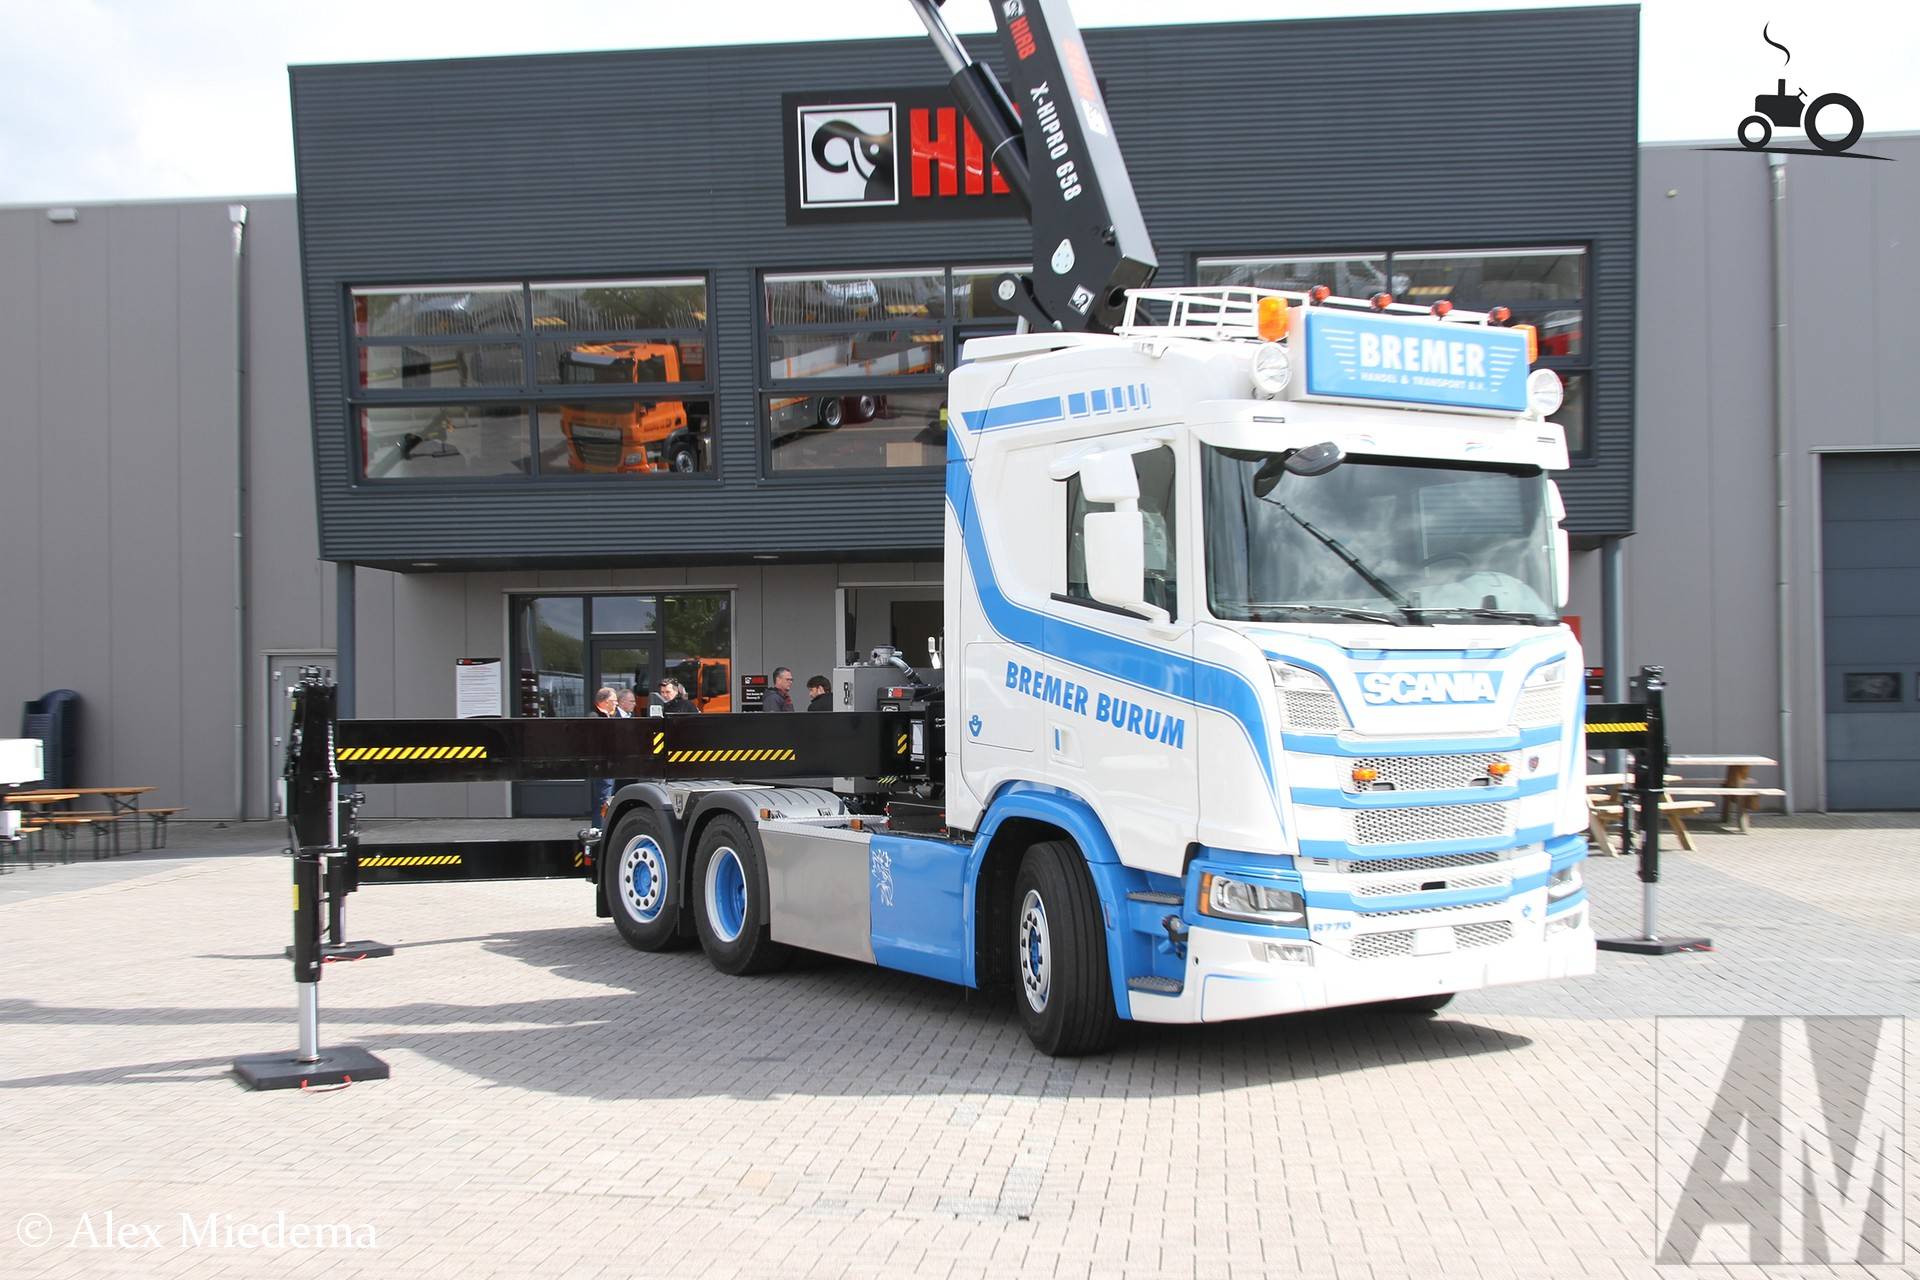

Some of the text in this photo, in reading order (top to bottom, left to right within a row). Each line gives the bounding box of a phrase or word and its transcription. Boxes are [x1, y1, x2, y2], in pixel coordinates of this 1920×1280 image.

[1009, 15, 1037, 60] HIAB
[910, 104, 1021, 197] HI
[1030, 80, 1082, 201] X-HIPRO 658
[1359, 331, 1487, 379] BREMER
[1005, 660, 1185, 750] BREMER BURUM
[1362, 672, 1496, 704] SCANIA
